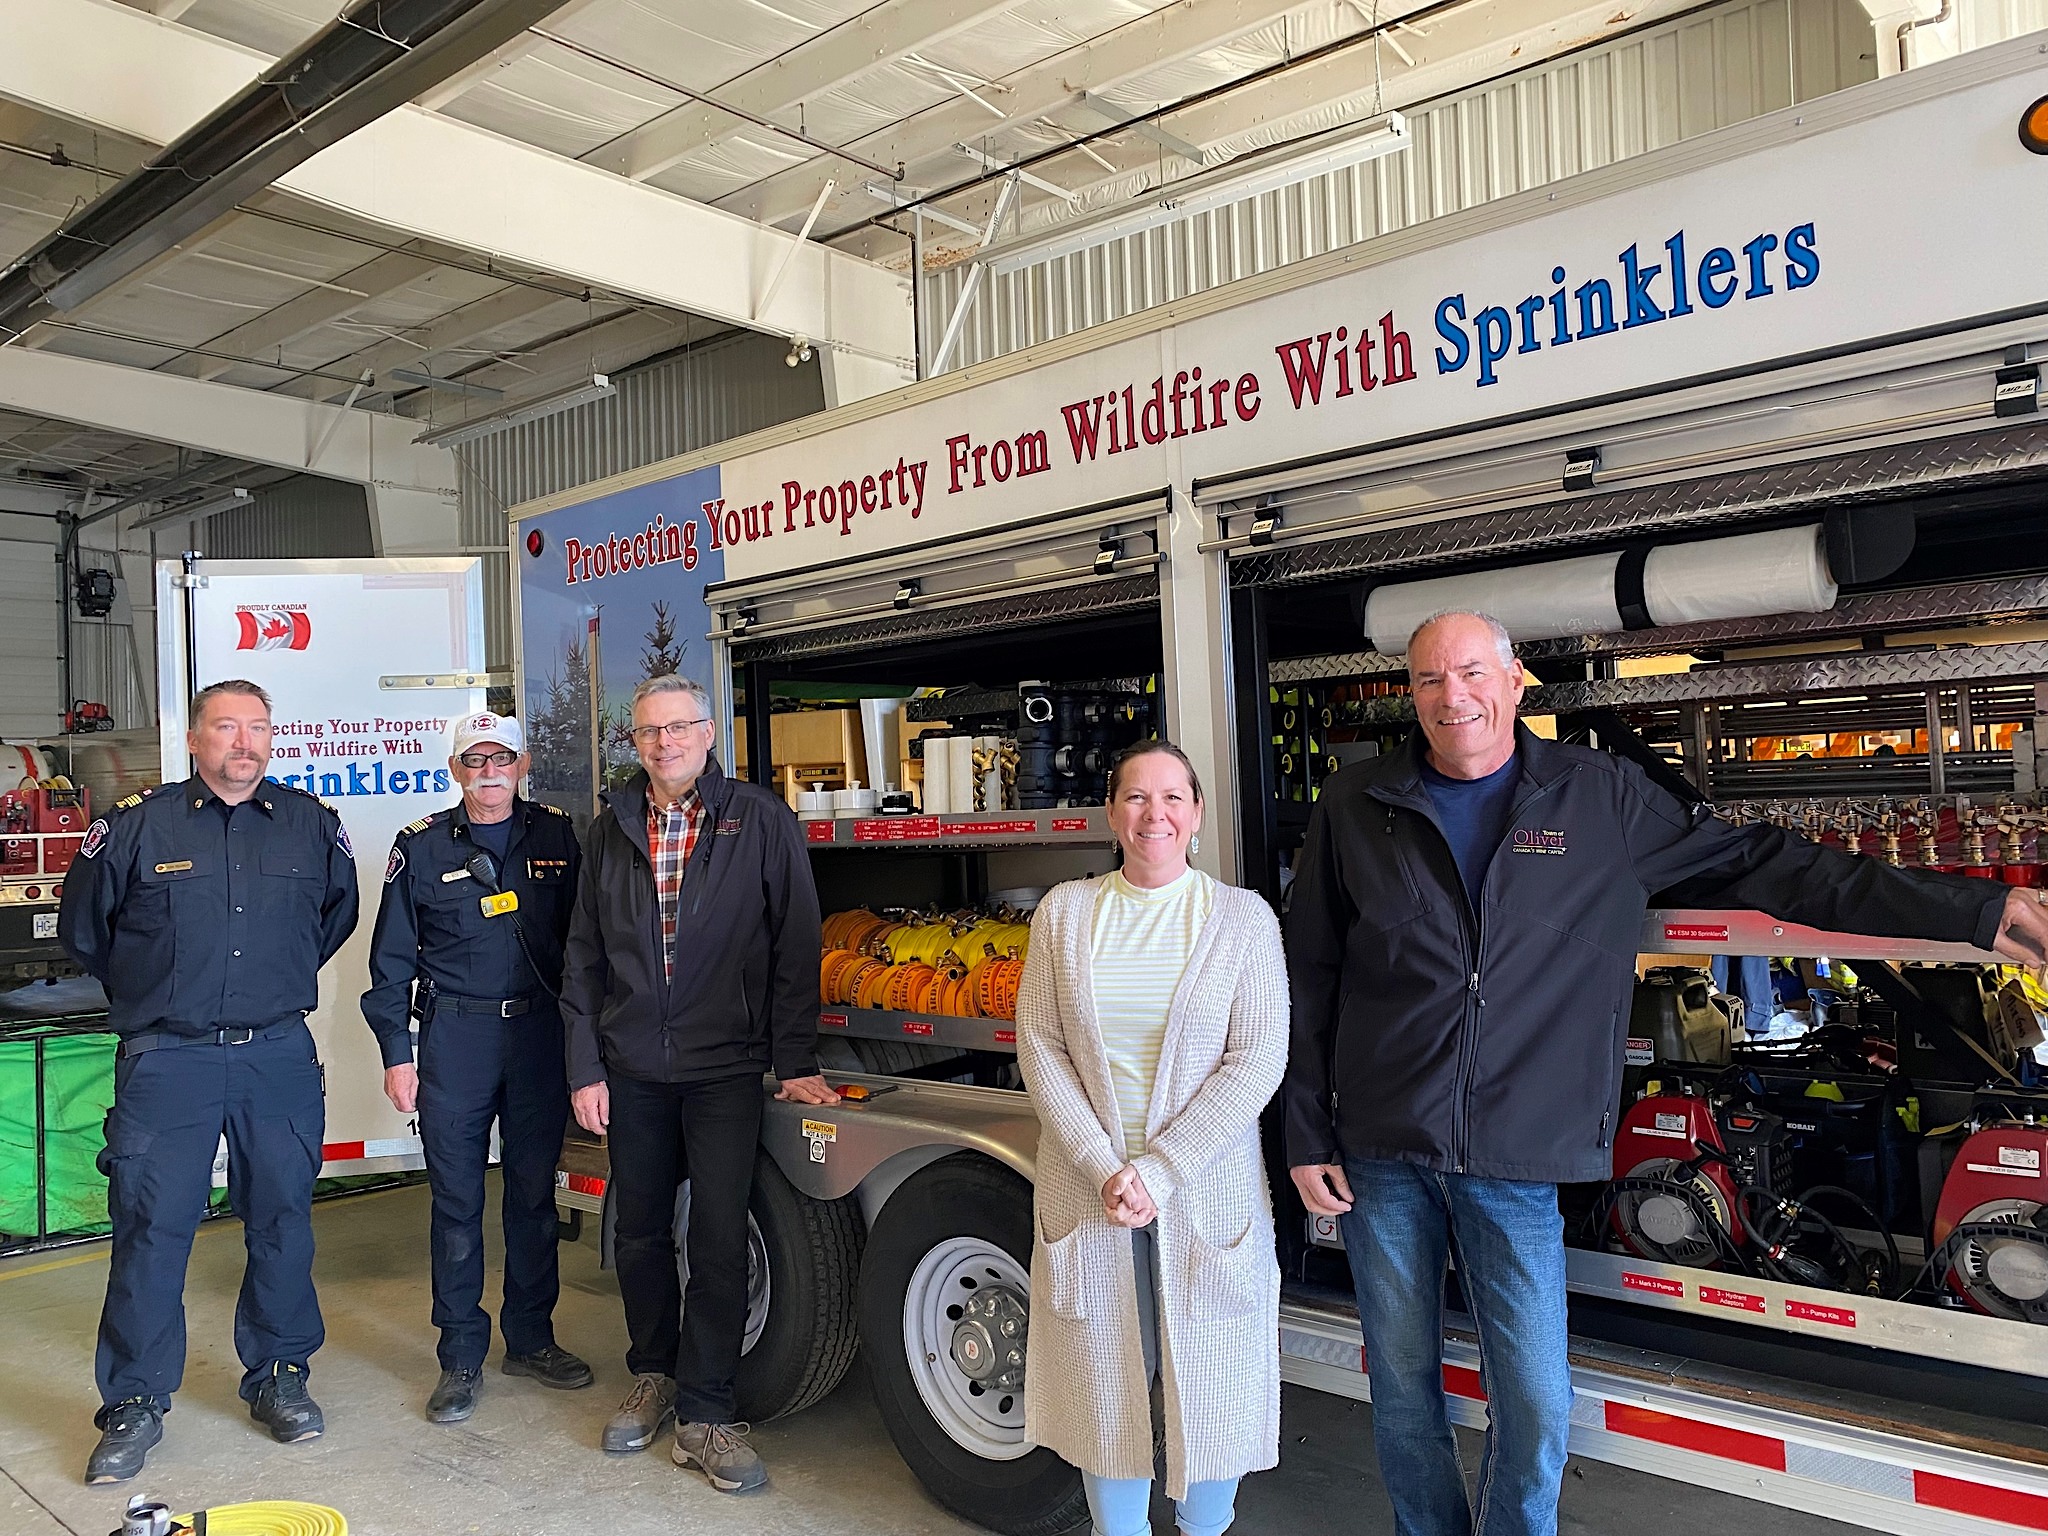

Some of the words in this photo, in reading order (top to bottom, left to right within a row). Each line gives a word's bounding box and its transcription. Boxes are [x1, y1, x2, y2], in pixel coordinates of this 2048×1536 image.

[565, 514, 699, 584] Protecting
[703, 498, 774, 551] Your
[782, 456, 928, 536] Property
[946, 430, 1051, 494] From
[1060, 366, 1262, 465] Wildfire
[1275, 310, 1418, 410] With
[1434, 222, 1821, 387] Sprinklers
[271, 603, 307, 611] CANADIAN
[272, 720, 323, 738] ecting
[328, 719, 369, 734] Your
[374, 717, 448, 736] Property
[270, 746, 301, 759] rom
[306, 741, 378, 758] Wildfire
[382, 739, 423, 755] With
[265, 761, 451, 797] rinklers
[1514, 829, 1565, 846] Oliver
[1626, 1041, 1648, 1049] ANGER
[809, 1122, 834, 1133] CAUTION
[1786, 1122, 1816, 1131] KOBALT
[1638, 1279, 1652, 1287] Mark
[1657, 1282, 1675, 1292] Pumps
[1725, 1292, 1747, 1301] Hydrant
[1719, 1298, 1744, 1307] Adaptors
[1810, 1309, 1827, 1318] Pump
[1828, 1312, 1840, 1320] Kits
